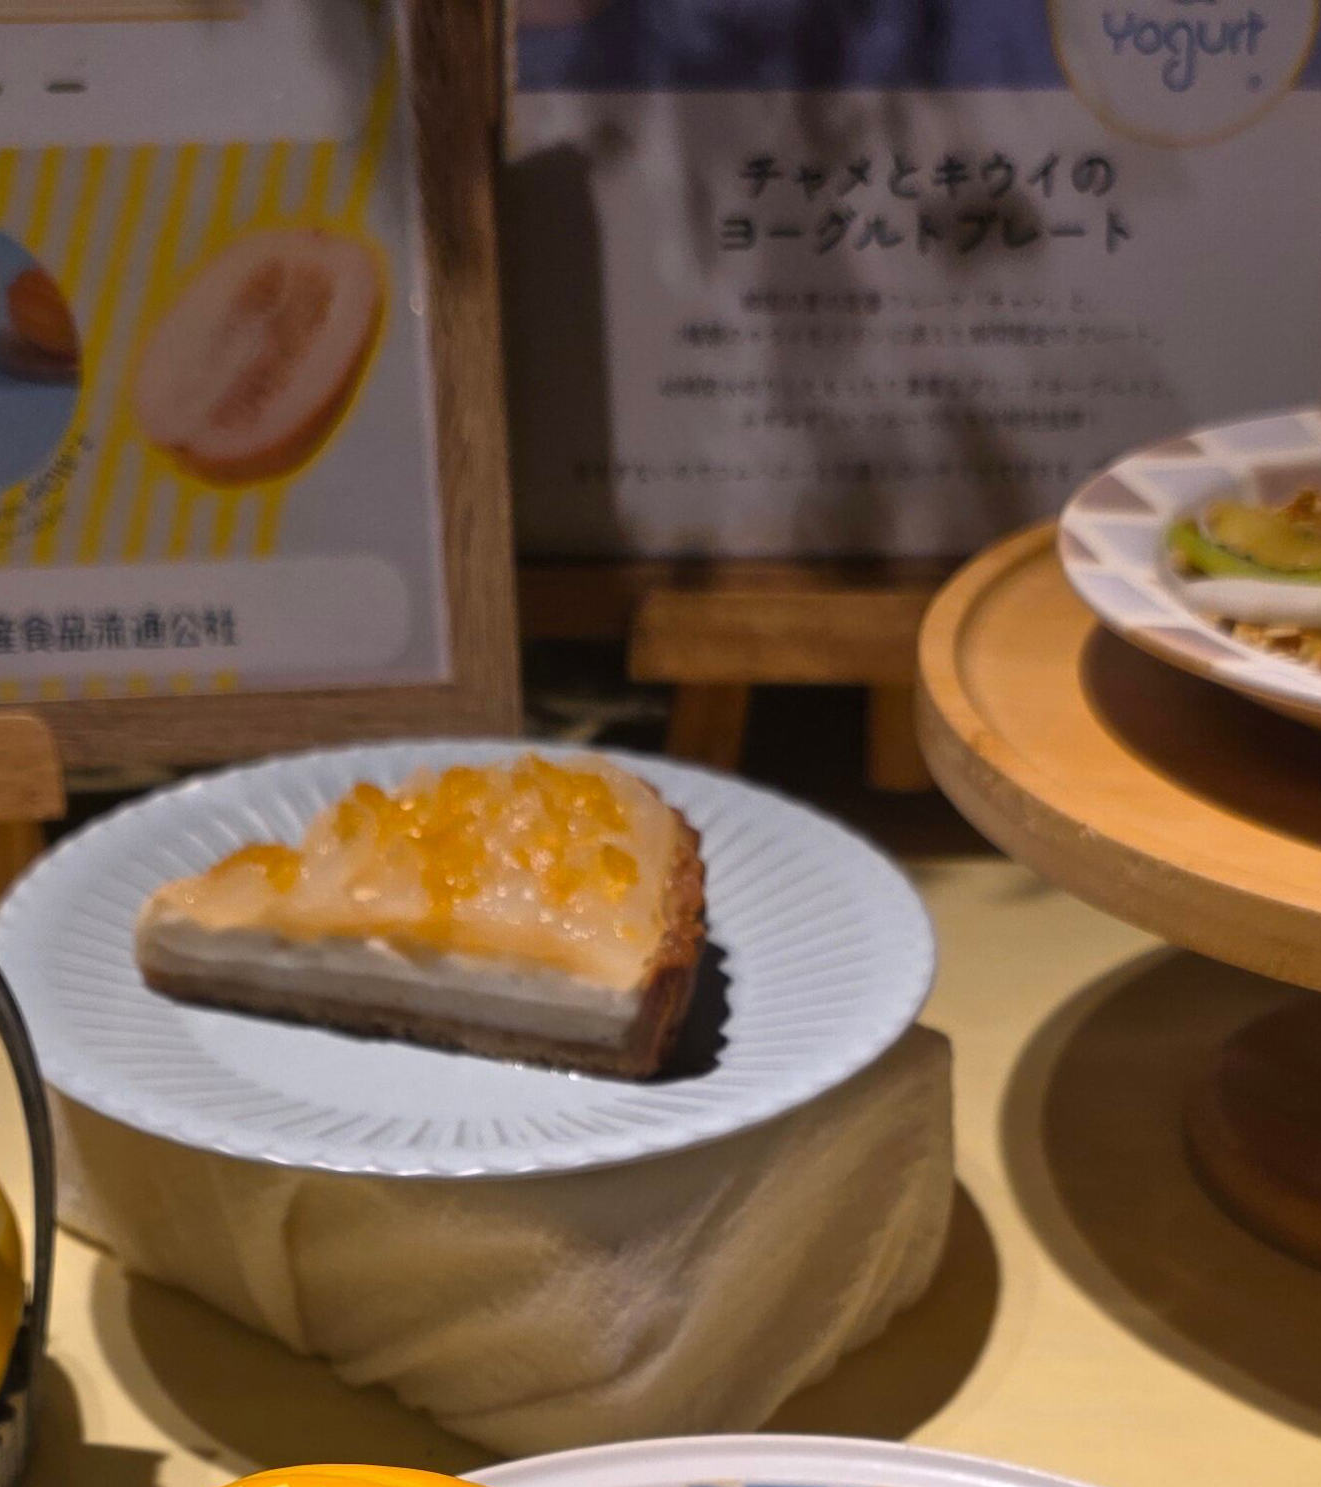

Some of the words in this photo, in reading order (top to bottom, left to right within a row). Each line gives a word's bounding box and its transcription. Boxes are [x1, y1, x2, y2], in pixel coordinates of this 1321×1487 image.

[1102, 9, 1268, 92] Yogurt
[740, 152, 1115, 199] チャメとキウイの
[720, 204, 1132, 256] ヨーグルトプレート
